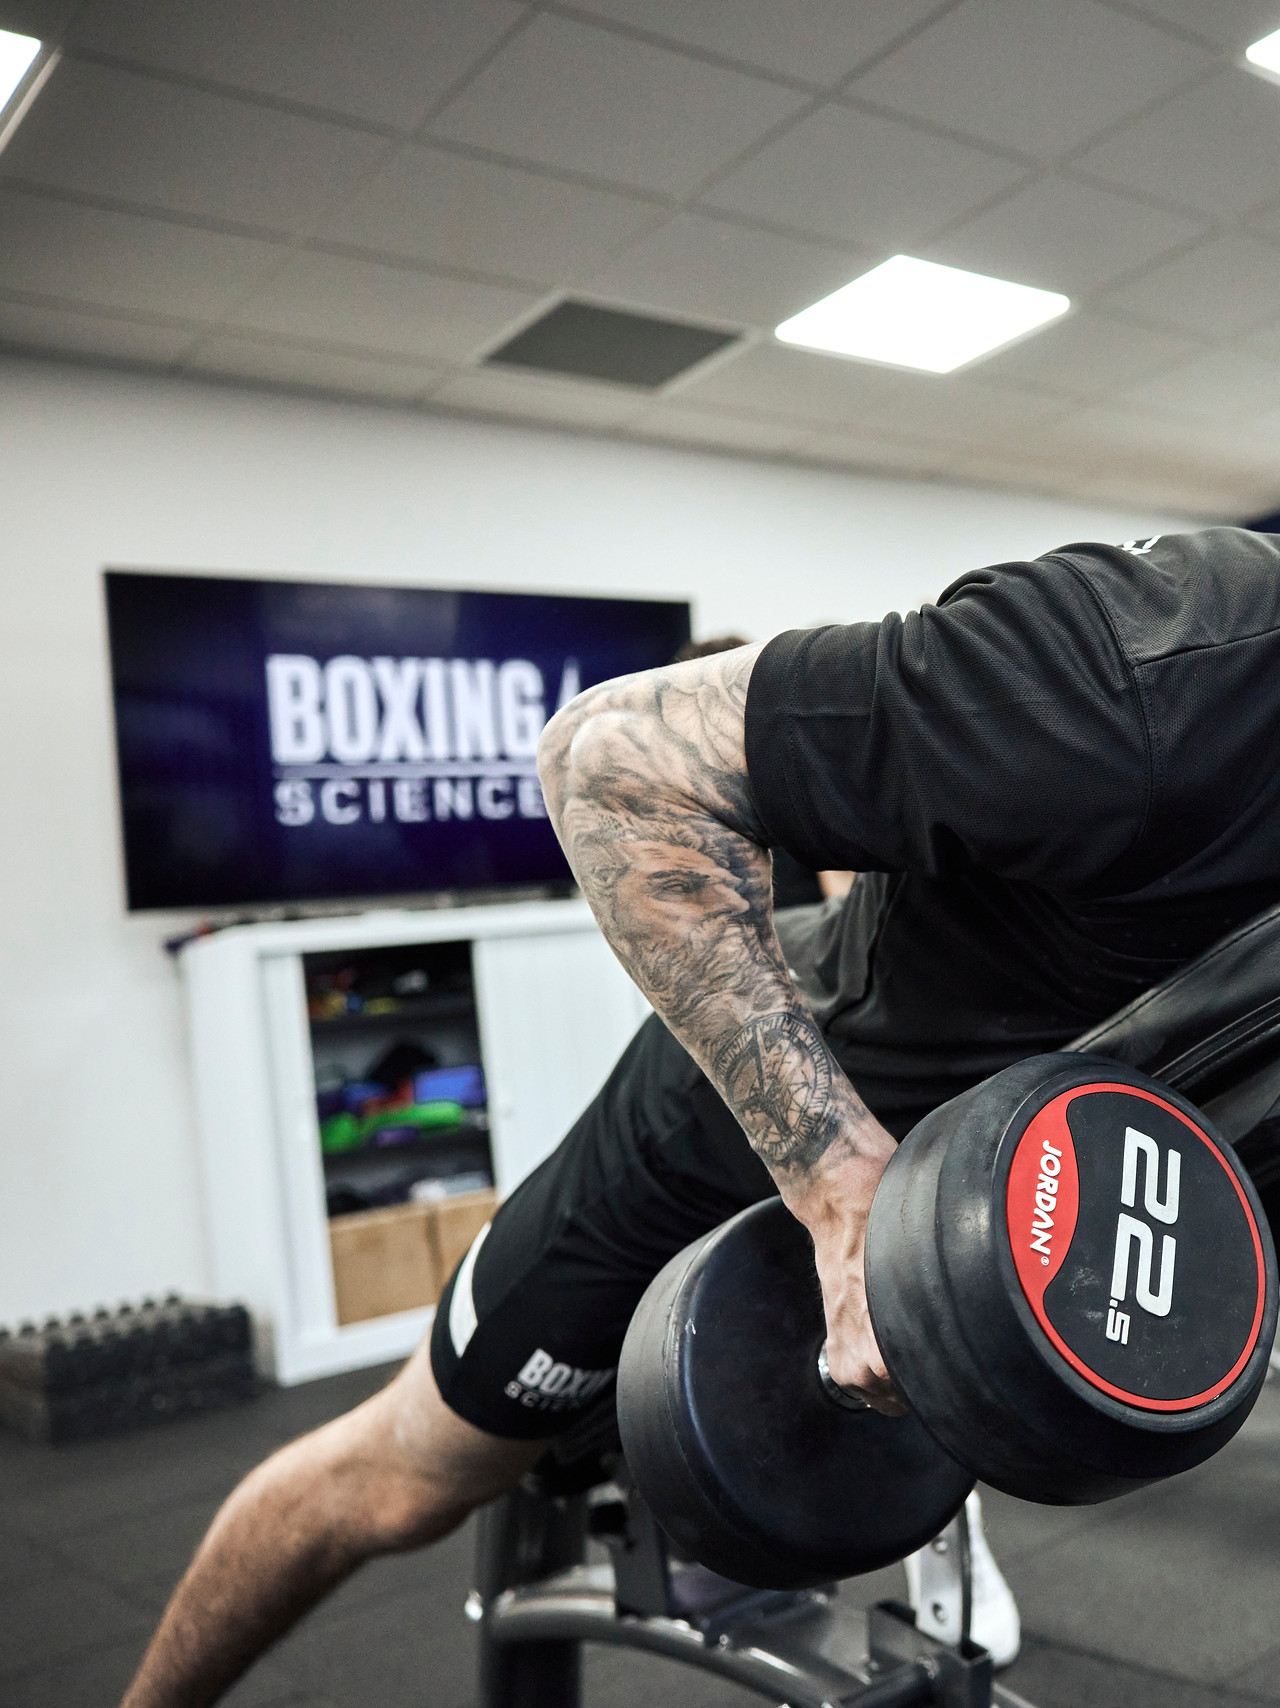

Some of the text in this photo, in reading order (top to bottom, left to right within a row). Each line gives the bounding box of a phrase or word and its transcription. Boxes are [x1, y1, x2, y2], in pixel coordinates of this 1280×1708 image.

[265, 654, 546, 765] BOXING
[273, 778, 547, 826] SCIENCE
[1106, 1126, 1181, 1345] 22.5
